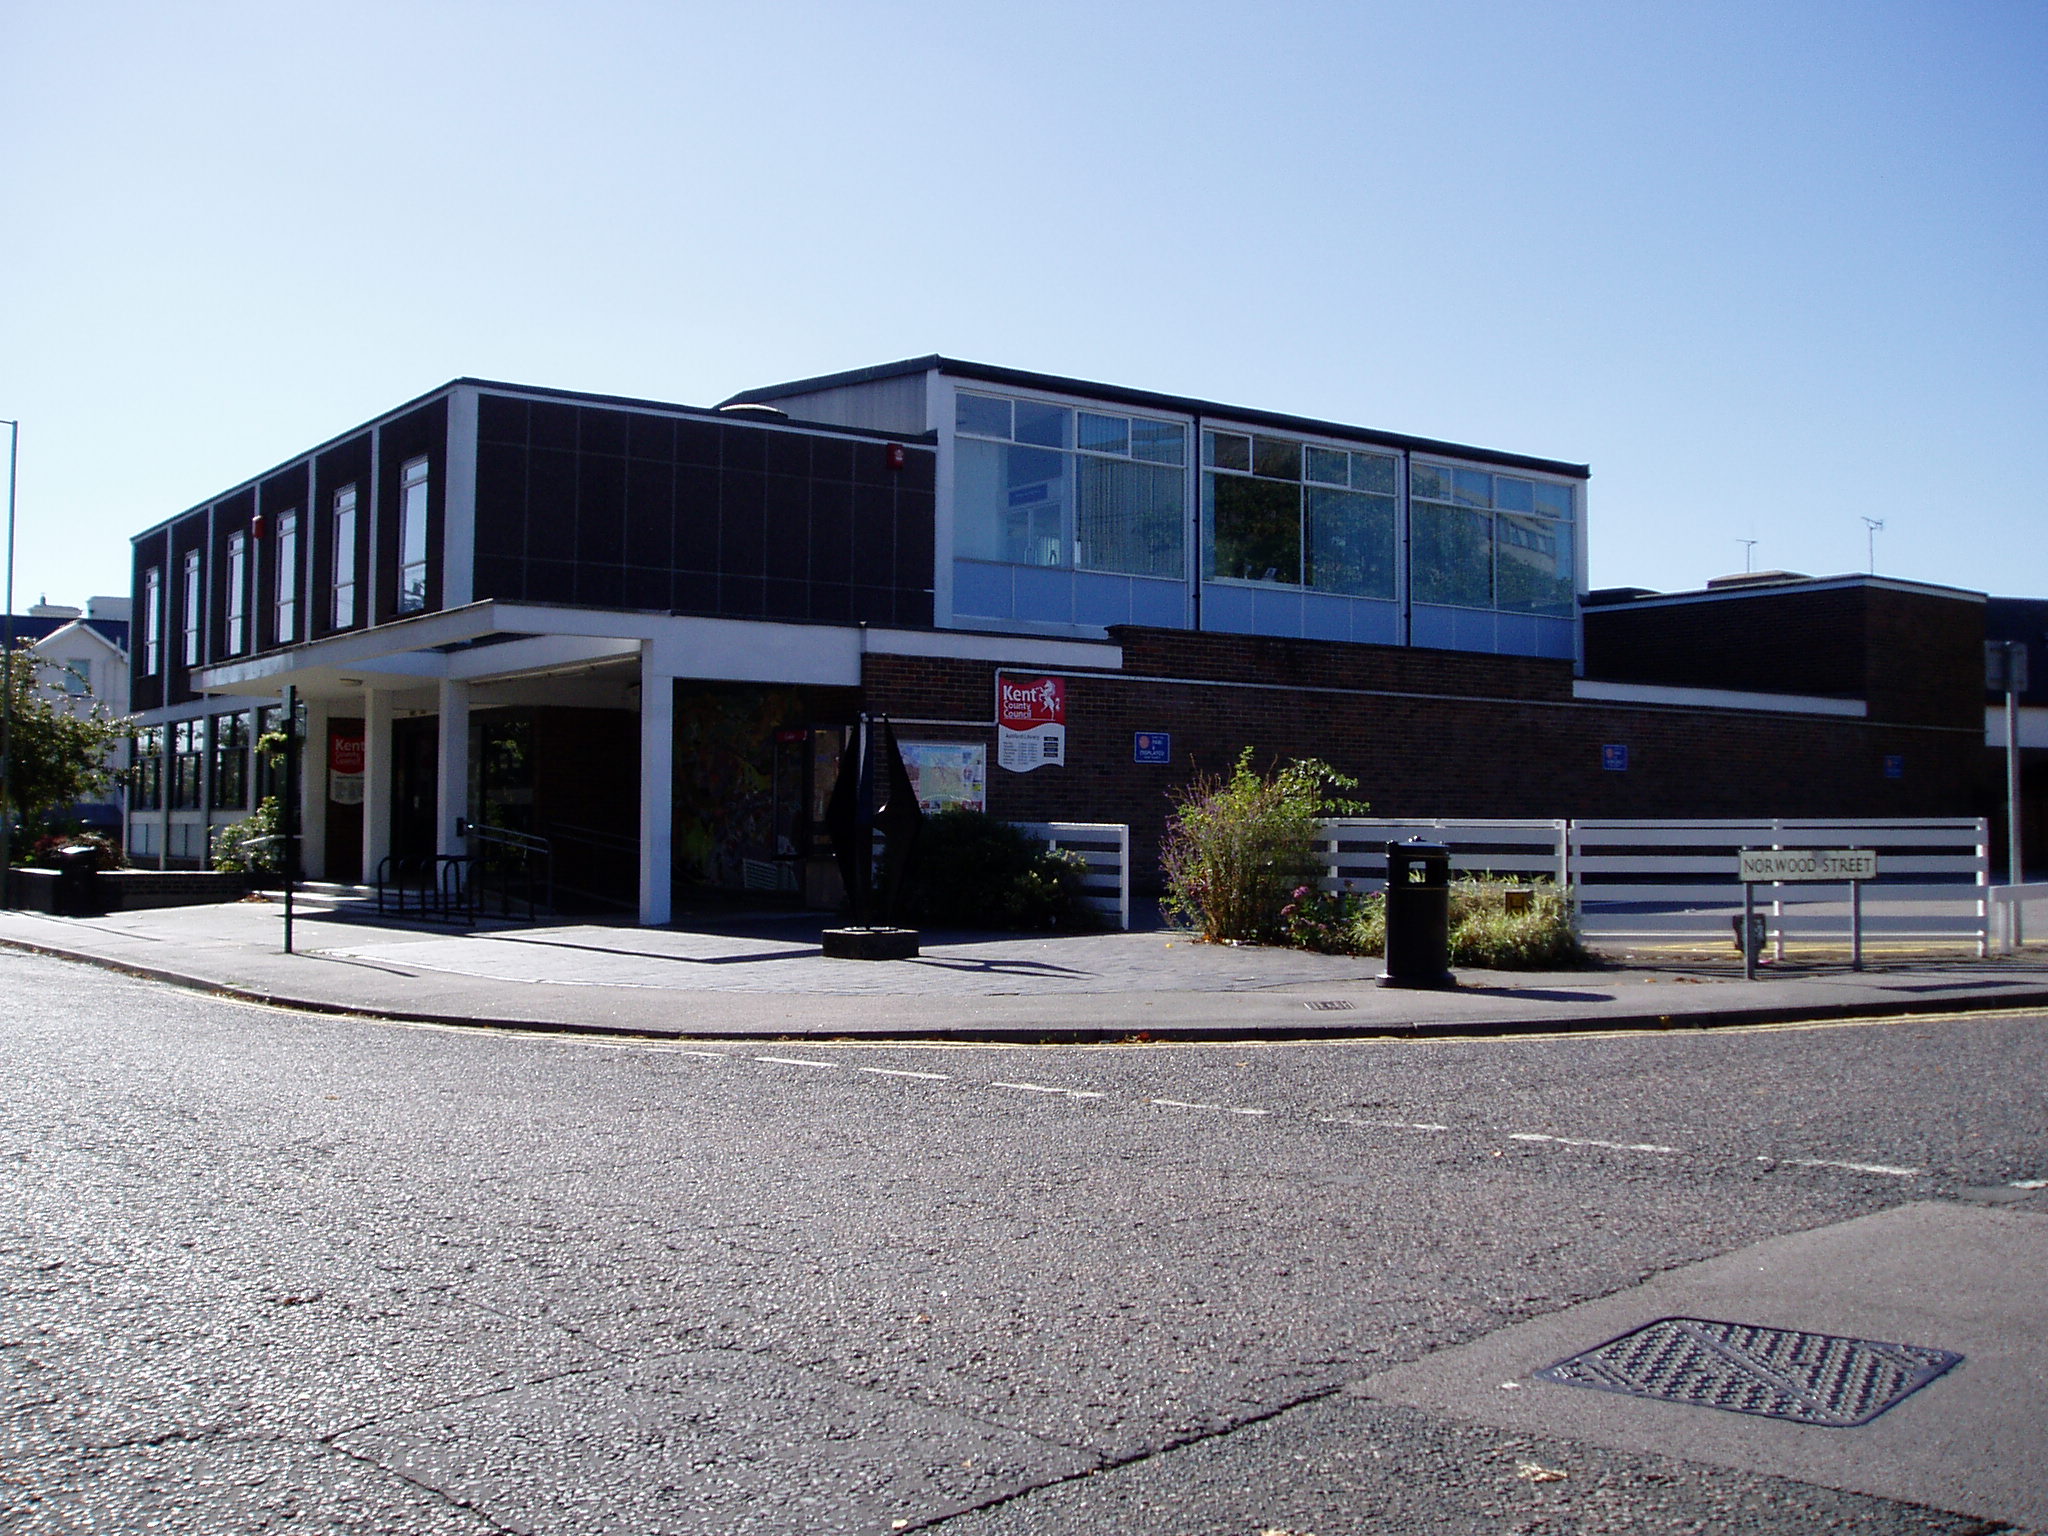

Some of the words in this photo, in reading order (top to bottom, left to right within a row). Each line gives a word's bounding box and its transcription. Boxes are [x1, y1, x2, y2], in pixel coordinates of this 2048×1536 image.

[1003, 685, 1037, 702] Kent
[1003, 701, 1031, 711] County
[1003, 709, 1032, 719] Council
[335, 739, 365, 751] Kent
[1744, 859, 1817, 873] NORWOOD
[1823, 858, 1872, 872] STREET
